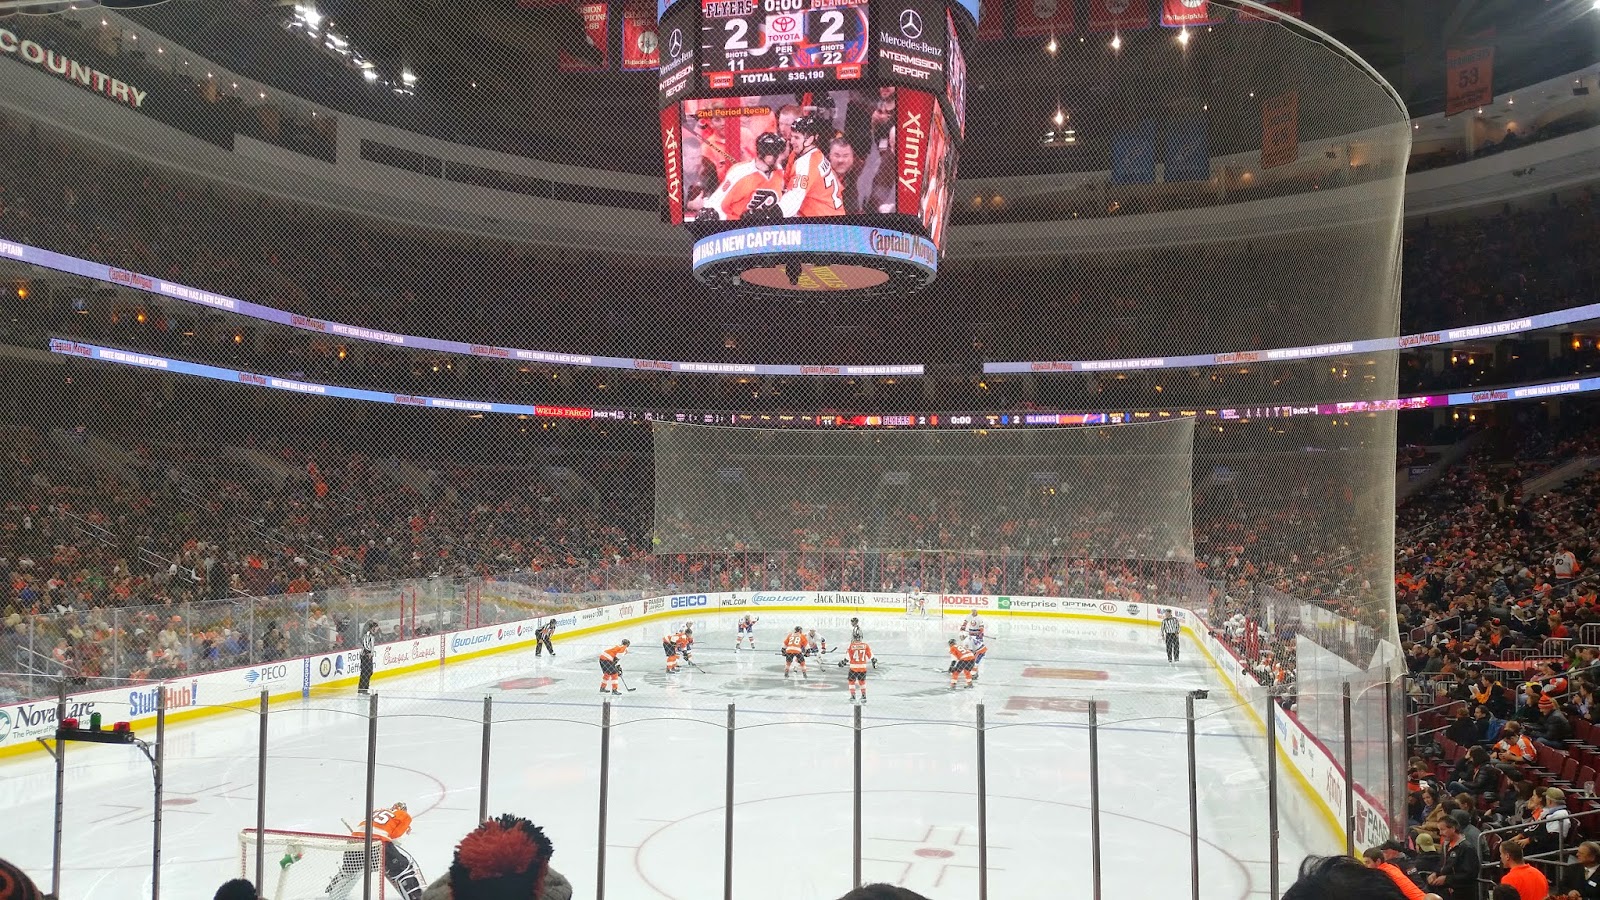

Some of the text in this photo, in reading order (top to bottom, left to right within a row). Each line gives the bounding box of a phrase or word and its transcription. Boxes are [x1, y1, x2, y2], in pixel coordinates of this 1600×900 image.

[705, 1, 753, 18] FLYERS
[765, 0, 803, 12] 0:00
[820, 11, 844, 42] 2
[724, 19, 748, 50] 2
[768, 33, 801, 42] TOYOTA
[775, 46, 793, 54] PER
[820, 44, 845, 53] SHOTS
[880, 31, 942, 56] Mercedes-Benz
[725, 51, 748, 59] SHOTS
[823, 52, 842, 64] 22
[880, 49, 943, 71] INTERMISSION
[0, 28, 147, 108] COUNTRY
[727, 60, 745, 72] 11
[779, 56, 790, 68] 2
[659, 64, 694, 91] INTERMISSION
[741, 73, 777, 84] TOTAL
[788, 71, 824, 82] $36,190
[892, 64, 930, 79] REPORT
[665, 79, 687, 98] REPORT
[698, 106, 770, 117] 2nd Period Recap
[899, 111, 924, 194] xfinity
[665, 127, 680, 203] xfinity
[701, 241, 714, 259] HAS
[714, 239, 722, 255] A
[722, 234, 745, 253] NEW
[746, 230, 802, 249] CAPTAIN
[870, 229, 911, 257] Captain
[1449, 329, 1466, 339] WHITE
[1466, 327, 1480, 336] RUM
[1480, 325, 1492, 334] HAS
[1499, 322, 1510, 332] NEW
[1511, 319, 1532, 330] CAPTAIN
[1399, 336, 1421, 347] Captain
[536, 407, 591, 417] WELLS FARGO
[919, 416, 926, 424] 2
[951, 416, 971, 424] 0:00
[1026, 415, 1056, 424] ISLANDERS
[671, 595, 707, 608] GEICO
[722, 598, 747, 606] NHL.COM
[814, 593, 865, 605] JACK DANIEL'S
[938, 595, 989, 606] MODELL'S
[1062, 601, 1098, 609] OPTIMA
[1103, 604, 1115, 612] KIA
[503, 628, 516, 639] pepsi
[453, 637, 471, 648] BUD
[471, 633, 494, 645] LIGHT
[789, 636, 801, 645] 28
[853, 649, 866, 662] 47
[261, 665, 287, 681] PECO
[129, 680, 198, 717] StubHub!
[13, 697, 95, 730] NovaCare
[13, 731, 25, 741] The
[26, 727, 44, 739] Power
